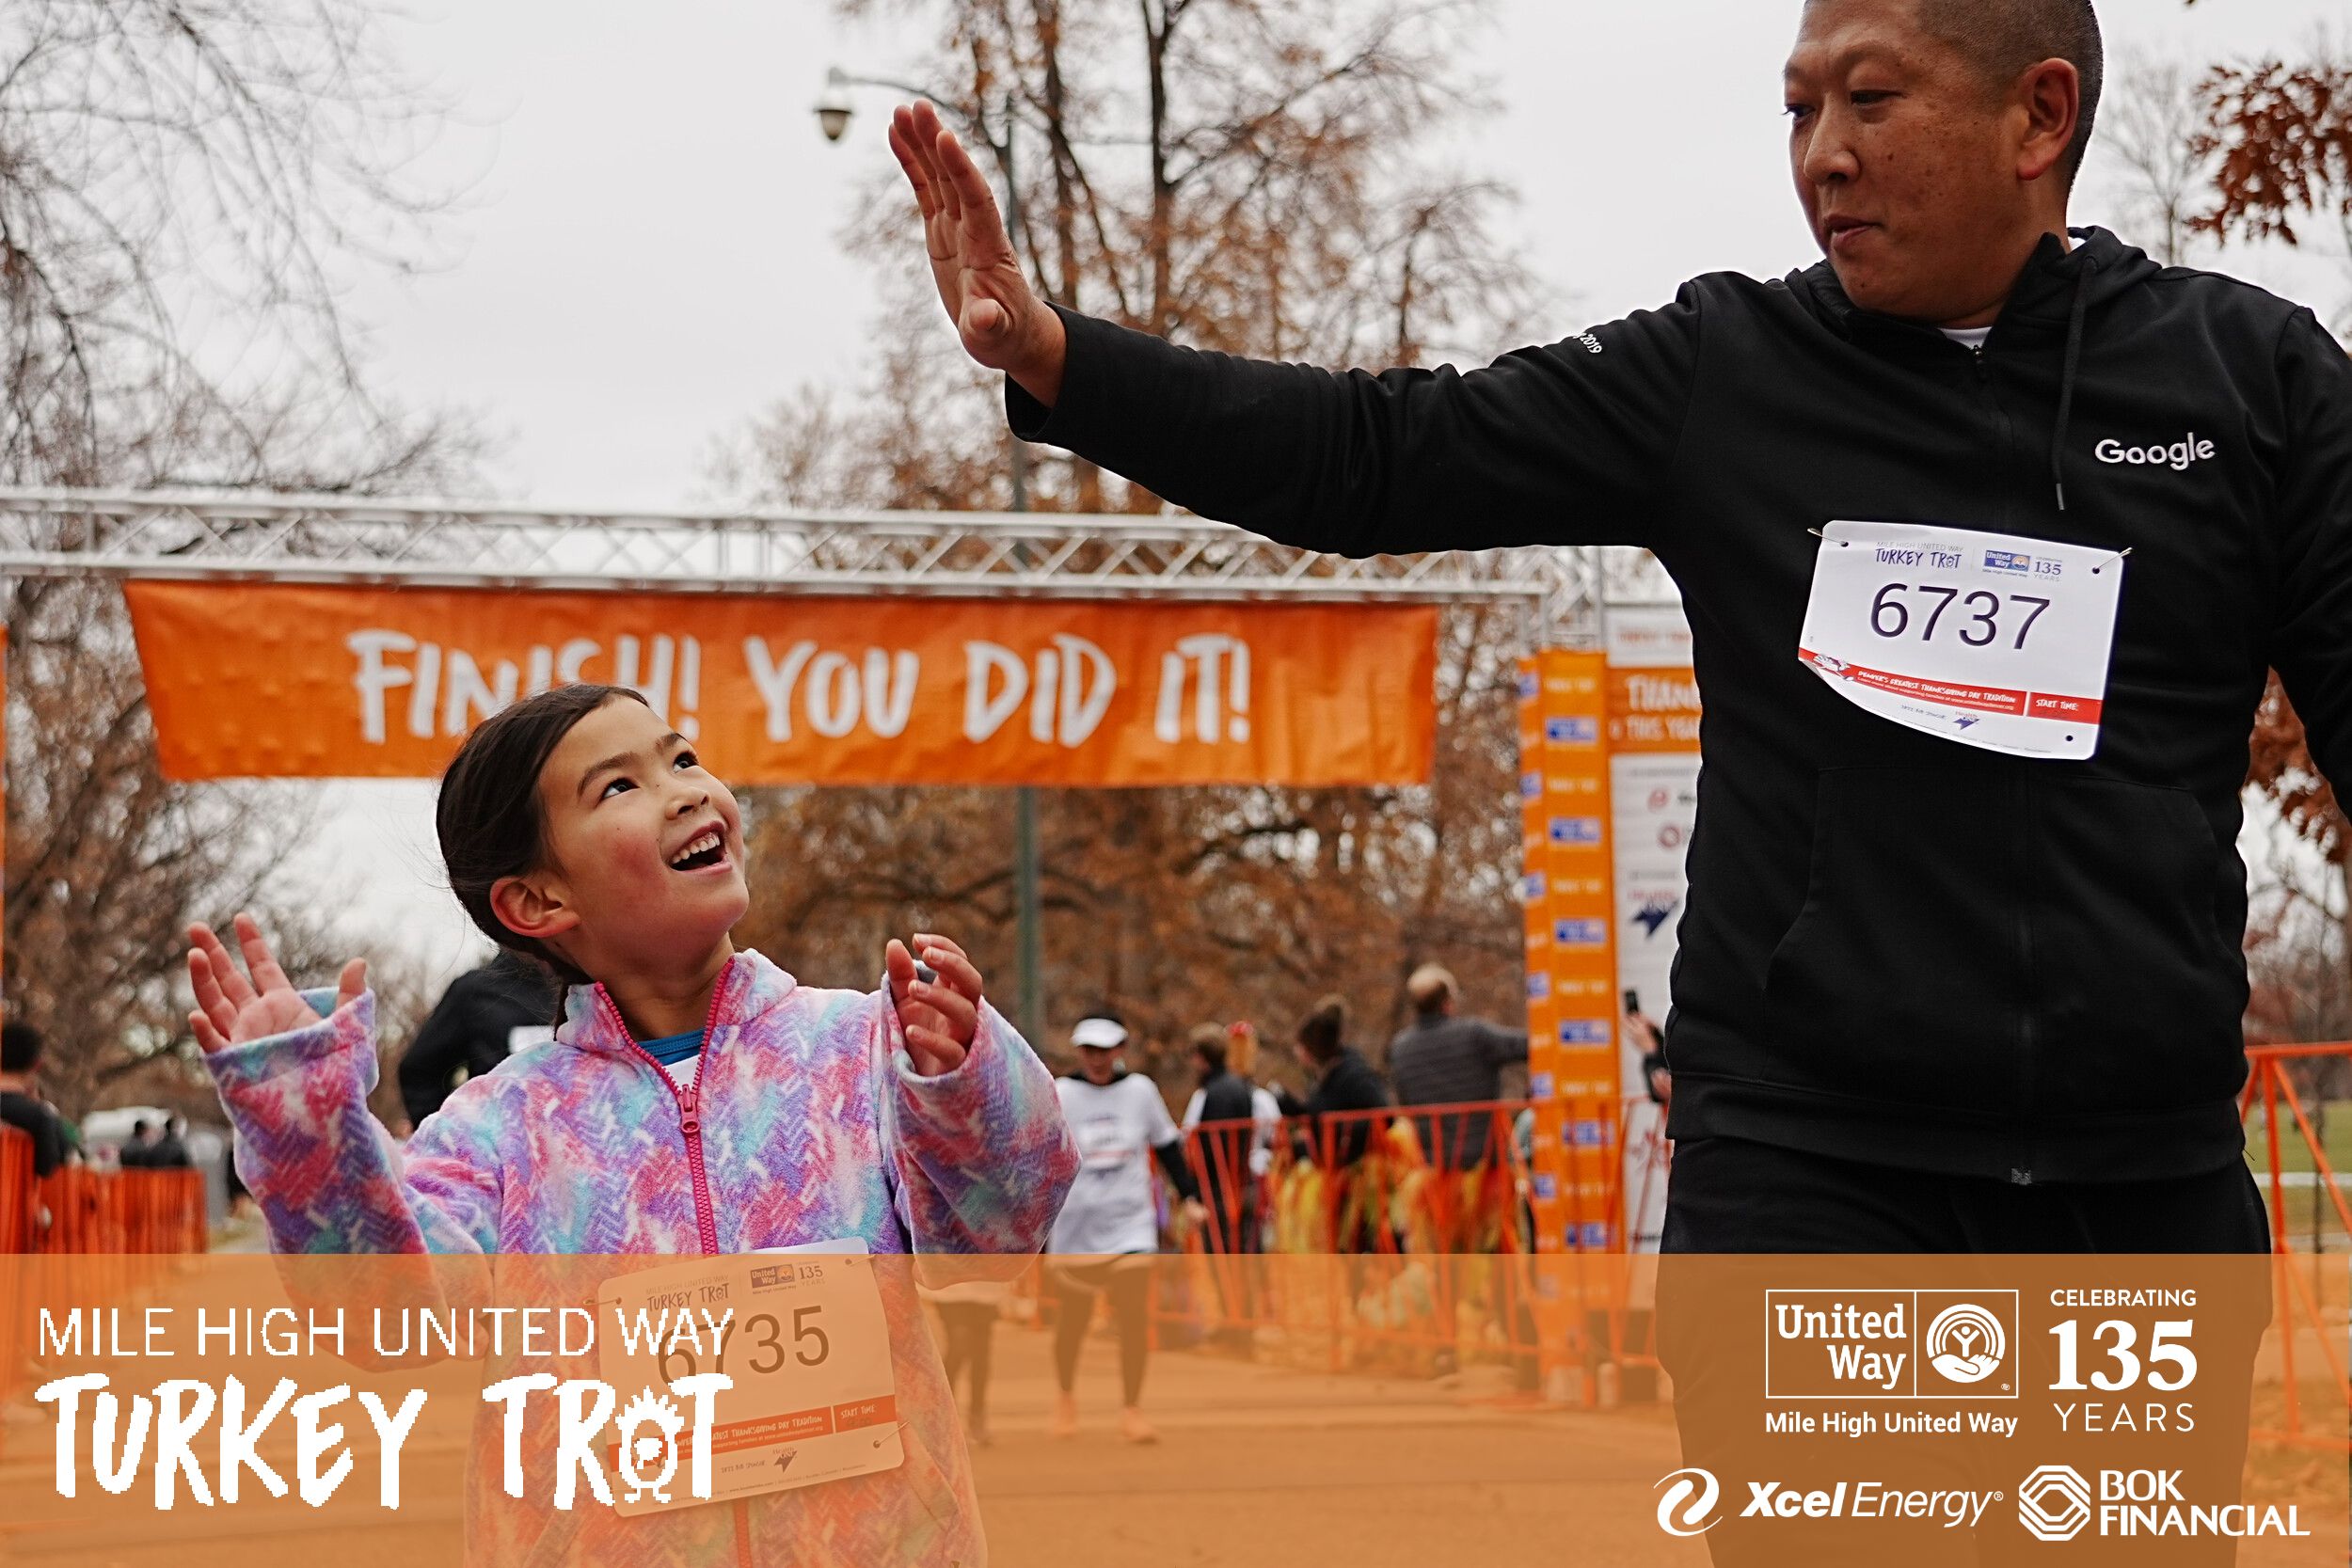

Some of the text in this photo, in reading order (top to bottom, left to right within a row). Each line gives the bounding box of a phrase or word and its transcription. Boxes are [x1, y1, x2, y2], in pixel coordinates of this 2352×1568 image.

[2095, 432, 2216, 470] Google
[1875, 548, 1962, 568] TURKEY TROT
[1986, 551, 2011, 561] United
[1994, 559, 2010, 568] Way
[2034, 561, 2062, 576] 135
[1870, 583, 2051, 650] 6737
[742, 636, 920, 743] YOU
[963, 632, 1118, 748] DID
[1154, 632, 1251, 744] IT!
[1889, 678, 1919, 689] GREATEST
[1920, 684, 1967, 698] THANKSGIVING
[1983, 692, 2016, 704] TRADITION
[2036, 699, 2057, 708] START
[752, 1267, 776, 1279] United
[761, 1275, 776, 1285] Way
[799, 1265, 823, 1280] 135
[647, 1282, 729, 1312] TURKEY TROT
[659, 1305, 830, 1390] 6735
[840, 1408, 860, 1419] START
[731, 1423, 776, 1438] THANKSGIVING
[778, 1420, 790, 1430] DAY
[792, 1416, 822, 1428] TRADITION
